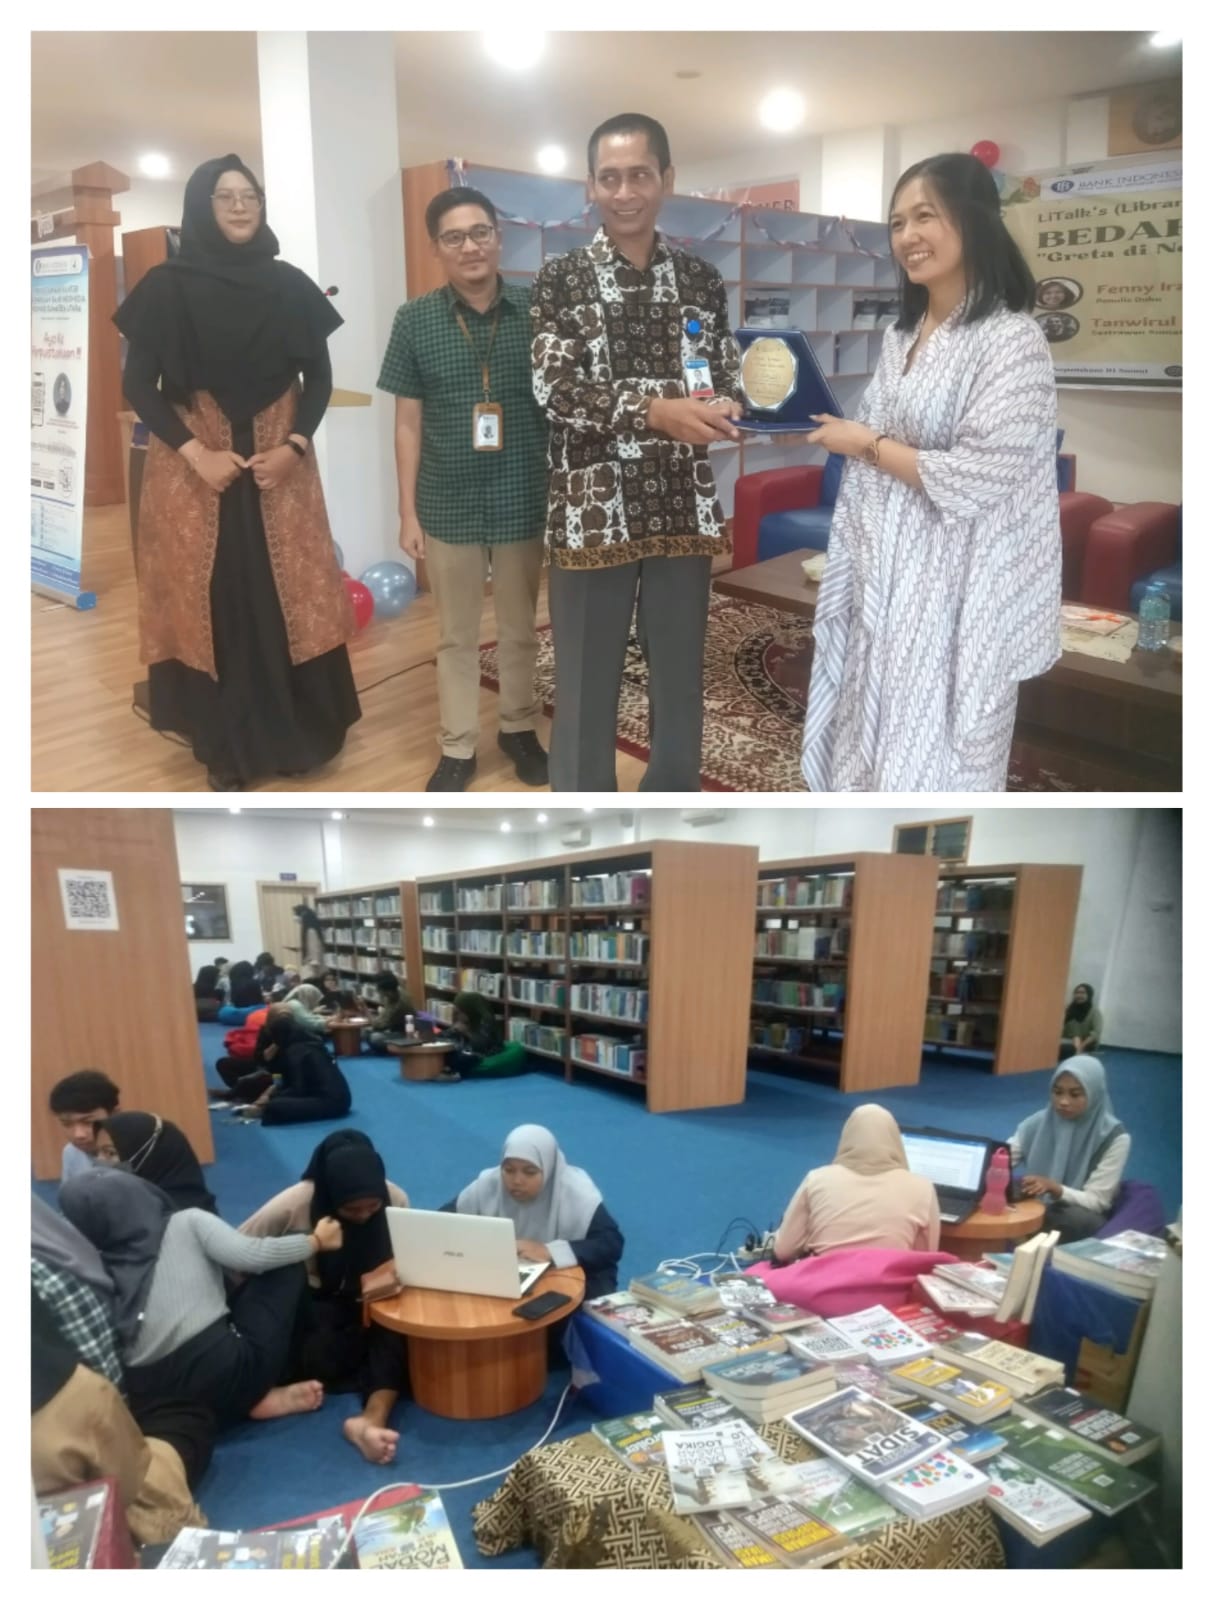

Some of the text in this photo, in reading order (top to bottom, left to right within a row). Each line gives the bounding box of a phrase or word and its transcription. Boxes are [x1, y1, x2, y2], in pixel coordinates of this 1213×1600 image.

[1079, 178, 1113, 188] BANK
[1123, 244, 1147, 256] di
[1096, 284, 1154, 296] Fenny
[1091, 315, 1176, 328] Tanwirul
[674, 1440, 722, 1449] LOGIKA
[855, 1424, 920, 1466] SIDAT
